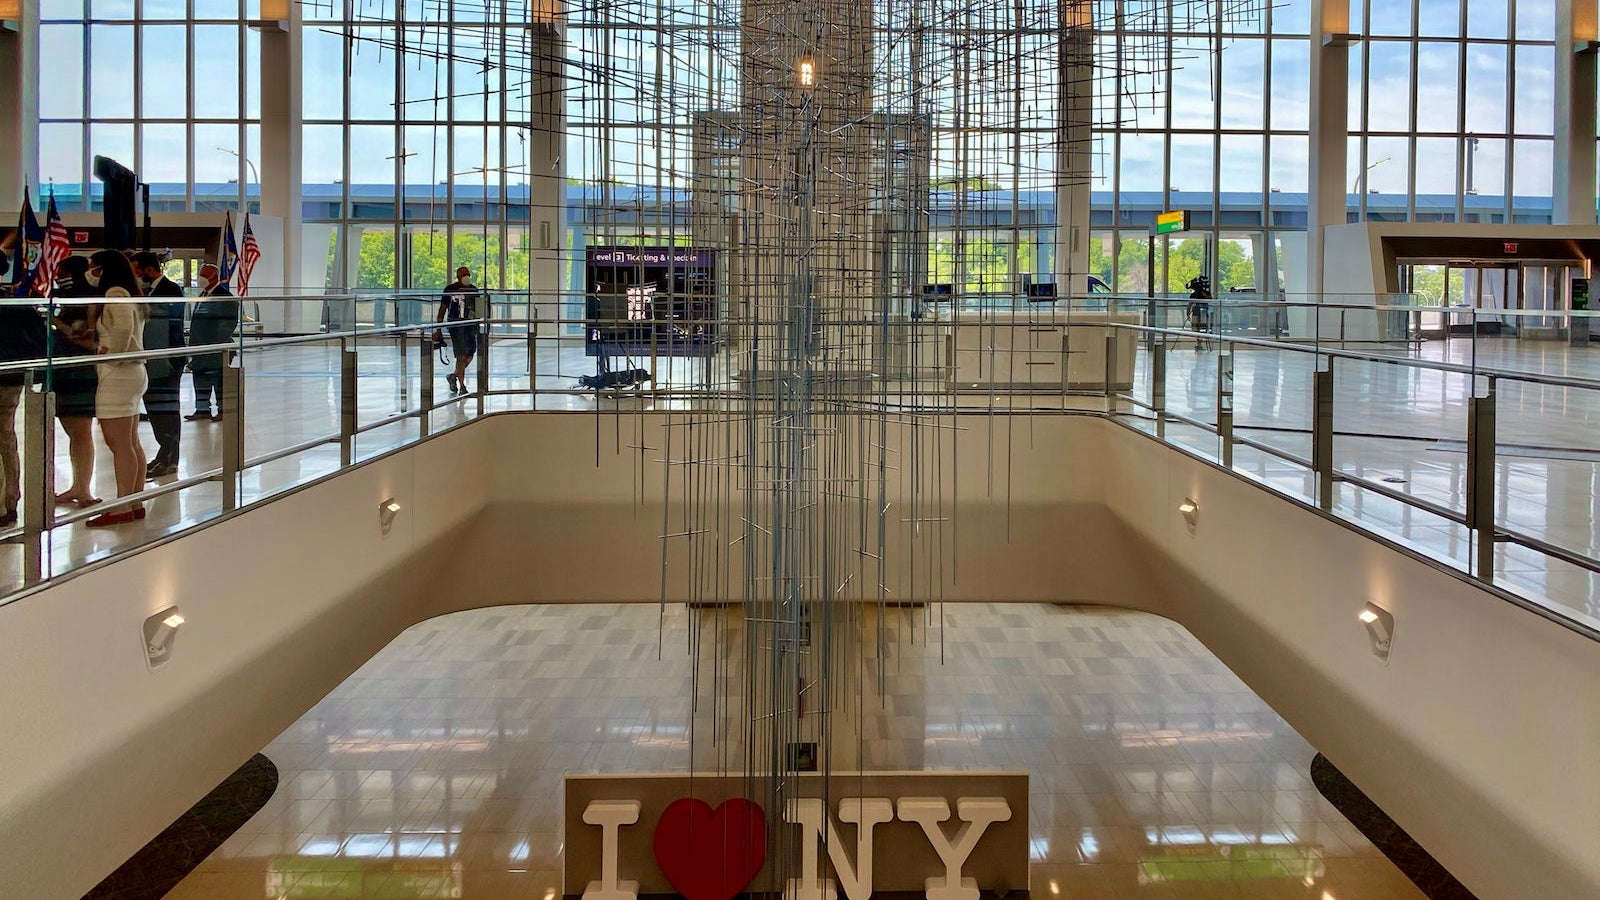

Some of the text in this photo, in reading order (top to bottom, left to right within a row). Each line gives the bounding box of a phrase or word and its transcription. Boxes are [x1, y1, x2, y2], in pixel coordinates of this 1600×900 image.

[626, 253, 659, 263] Tickting
[581, 796, 1012, 900] I NY
